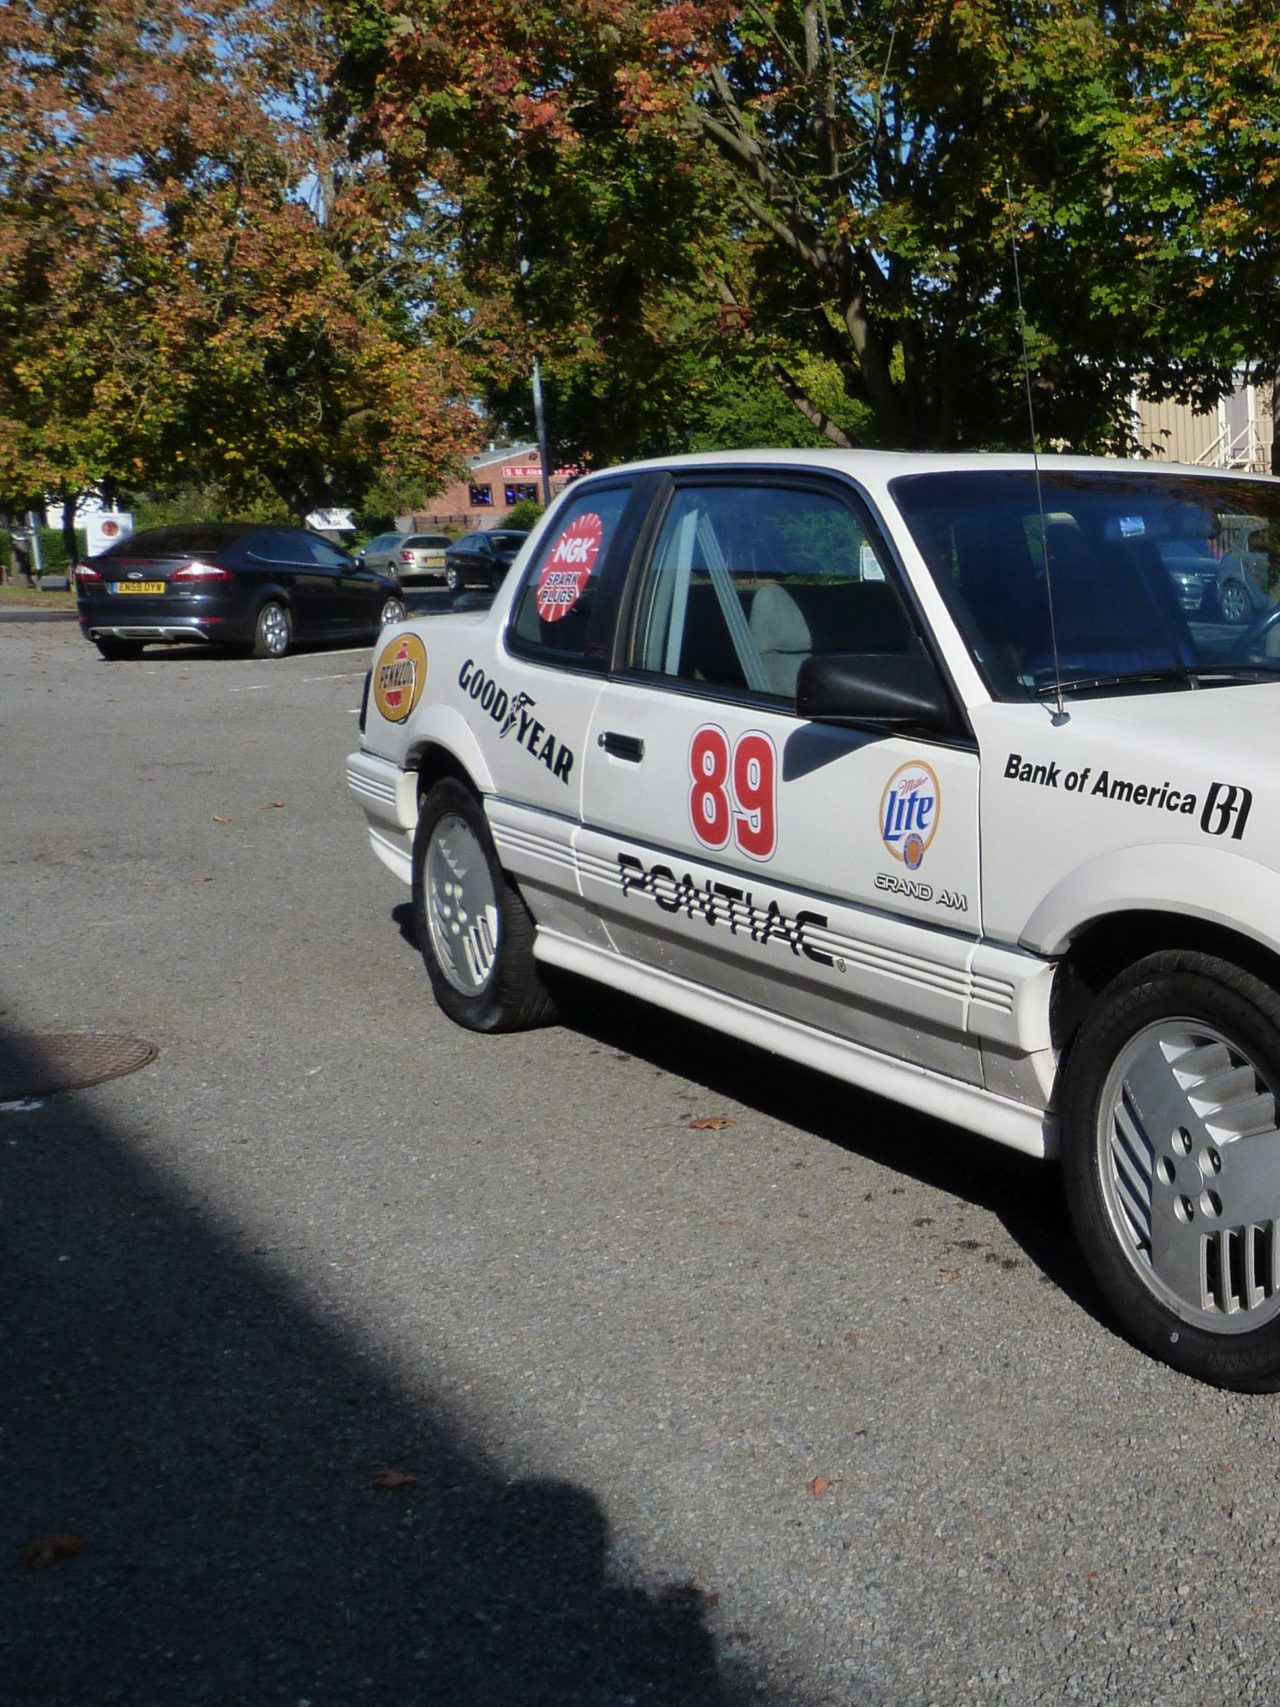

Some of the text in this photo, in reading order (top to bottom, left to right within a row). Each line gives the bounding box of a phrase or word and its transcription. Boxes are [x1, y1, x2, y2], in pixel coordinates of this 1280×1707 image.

[553, 537, 595, 563] NGK
[542, 588, 574, 603] PLUGS
[546, 573, 577, 586] SPARK
[458, 658, 575, 786] GOODYEAR
[689, 723, 778, 862] 89
[1003, 753, 1062, 788] Bank
[1064, 767, 1091, 792] of
[1091, 770, 1197, 815] America
[882, 790, 934, 842] Lite
[617, 852, 834, 967] PONTIAC
[874, 873, 968, 911] GRAND AM
